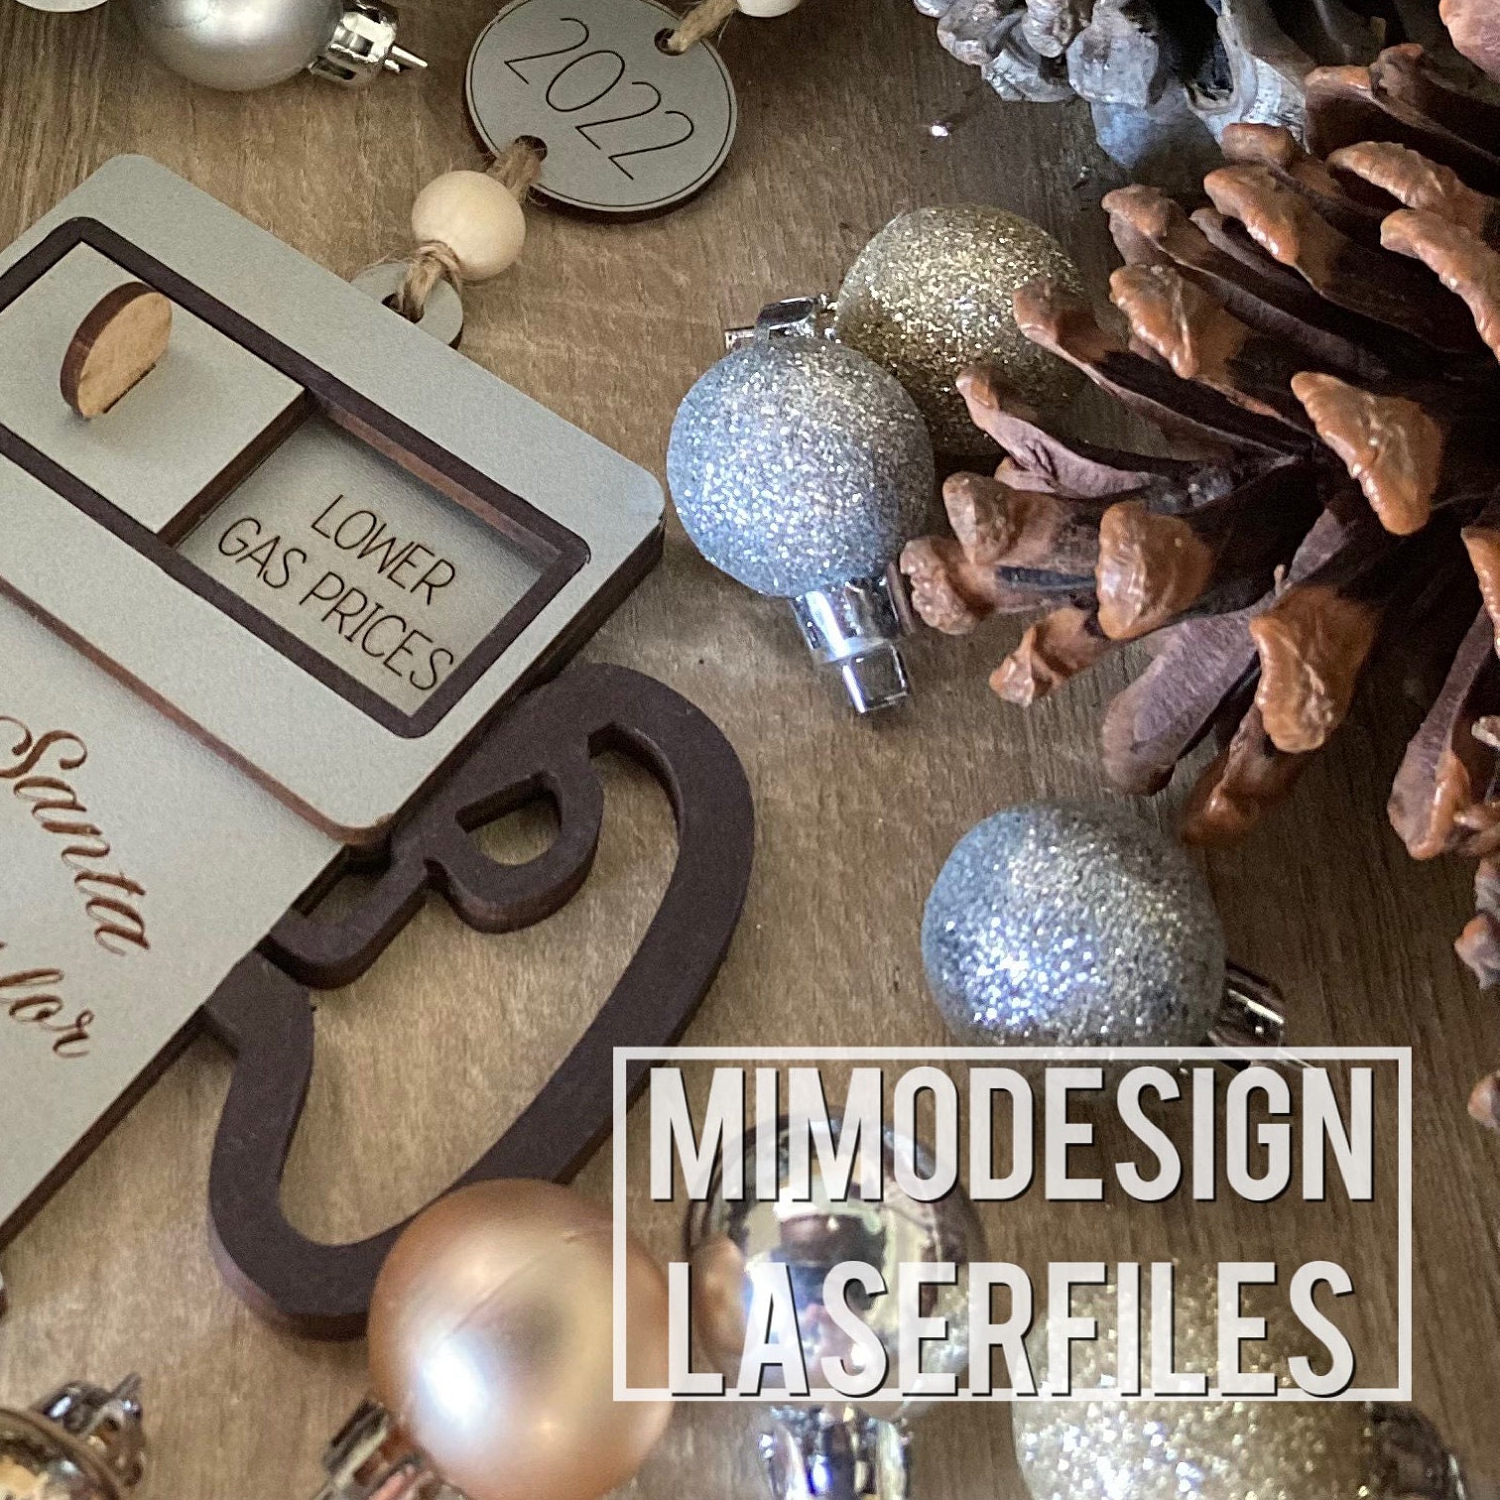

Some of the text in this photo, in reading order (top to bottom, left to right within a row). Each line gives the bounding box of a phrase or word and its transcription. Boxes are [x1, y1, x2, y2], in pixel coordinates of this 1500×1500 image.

[504, 17, 695, 181] 2022
[217, 516, 455, 692] GAS PRICES
[310, 494, 457, 606] LOWER
